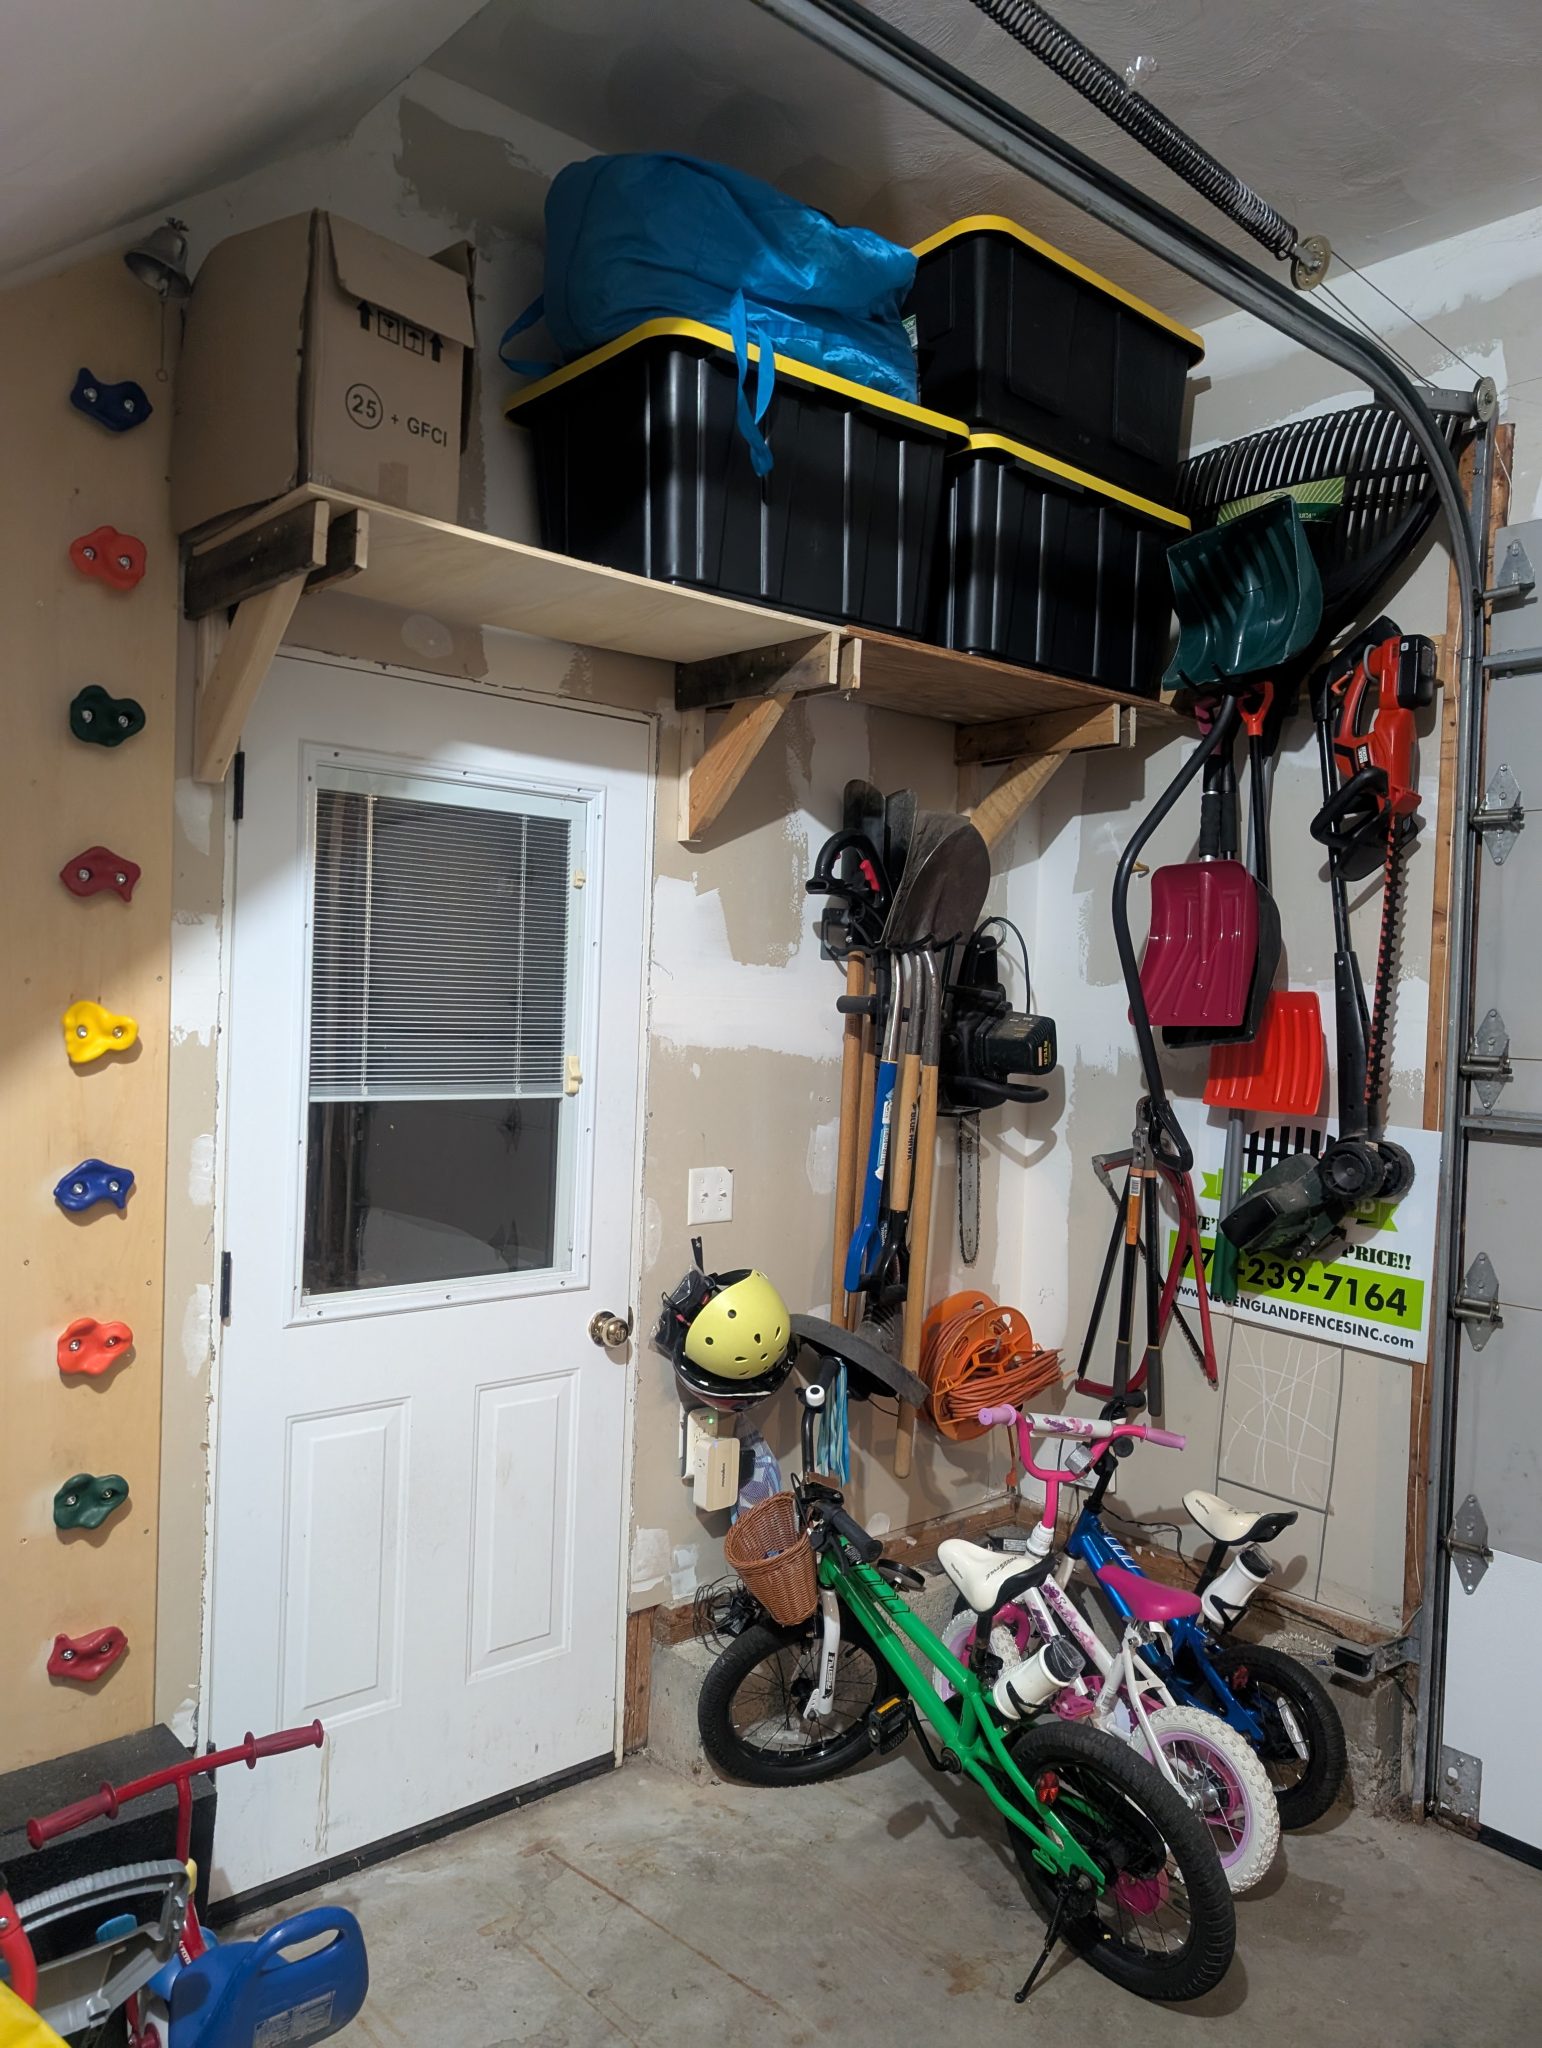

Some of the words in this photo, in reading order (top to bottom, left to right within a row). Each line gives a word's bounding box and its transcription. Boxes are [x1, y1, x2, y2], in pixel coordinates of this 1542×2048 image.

[352, 394, 377, 419] 25
[391, 414, 399, 425] +
[407, 416, 448, 448] GFCI
[1181, 1245, 1407, 1317] 77-239-7164
[1342, 1244, 1412, 1270] PRICE!!
